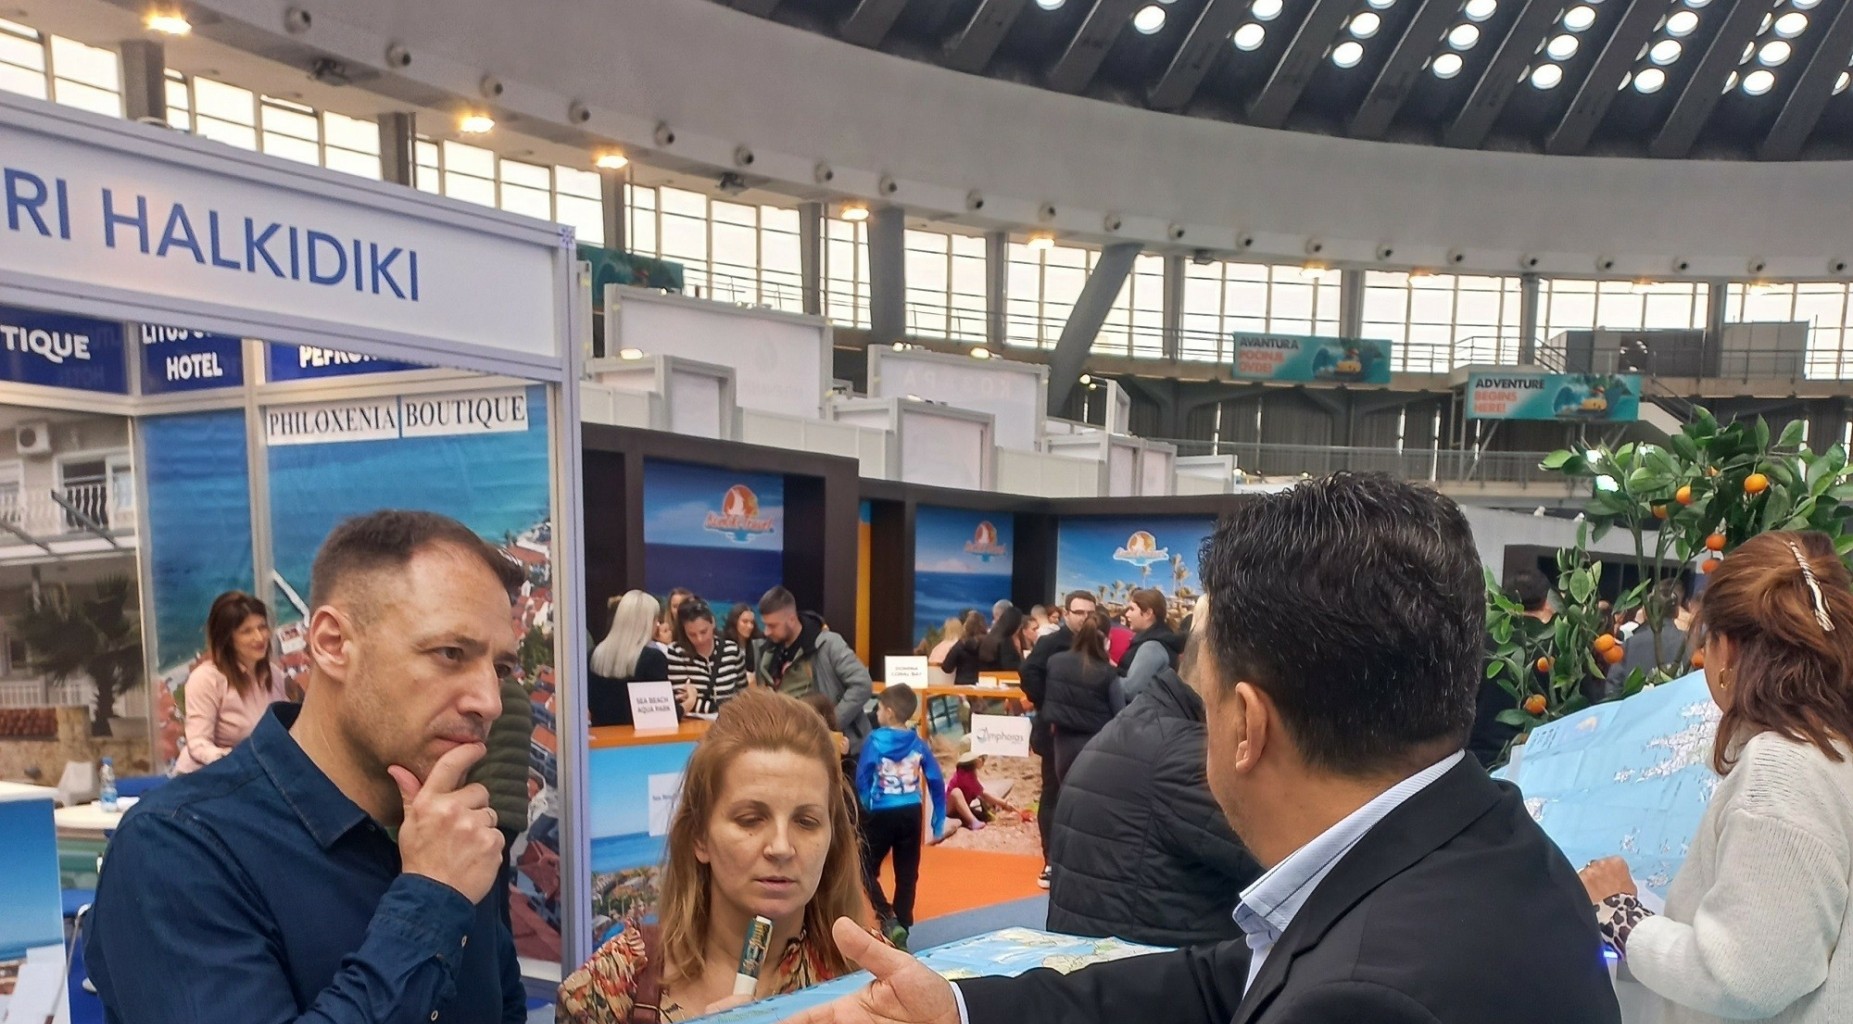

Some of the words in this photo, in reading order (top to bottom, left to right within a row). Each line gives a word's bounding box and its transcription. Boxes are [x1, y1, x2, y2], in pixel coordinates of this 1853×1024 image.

[4, 168, 71, 240] RI
[102, 187, 419, 302] HALKIDIKI
[0, 324, 91, 364] TIQUE
[1240, 336, 1299, 349] AVANTURA
[166, 352, 223, 381] HOTEL
[1474, 390, 1517, 402] BEGINS
[1475, 378, 1545, 389] ADVENTURE
[269, 405, 396, 436] PHILOXENIA
[405, 395, 525, 429] BOUTIQUE
